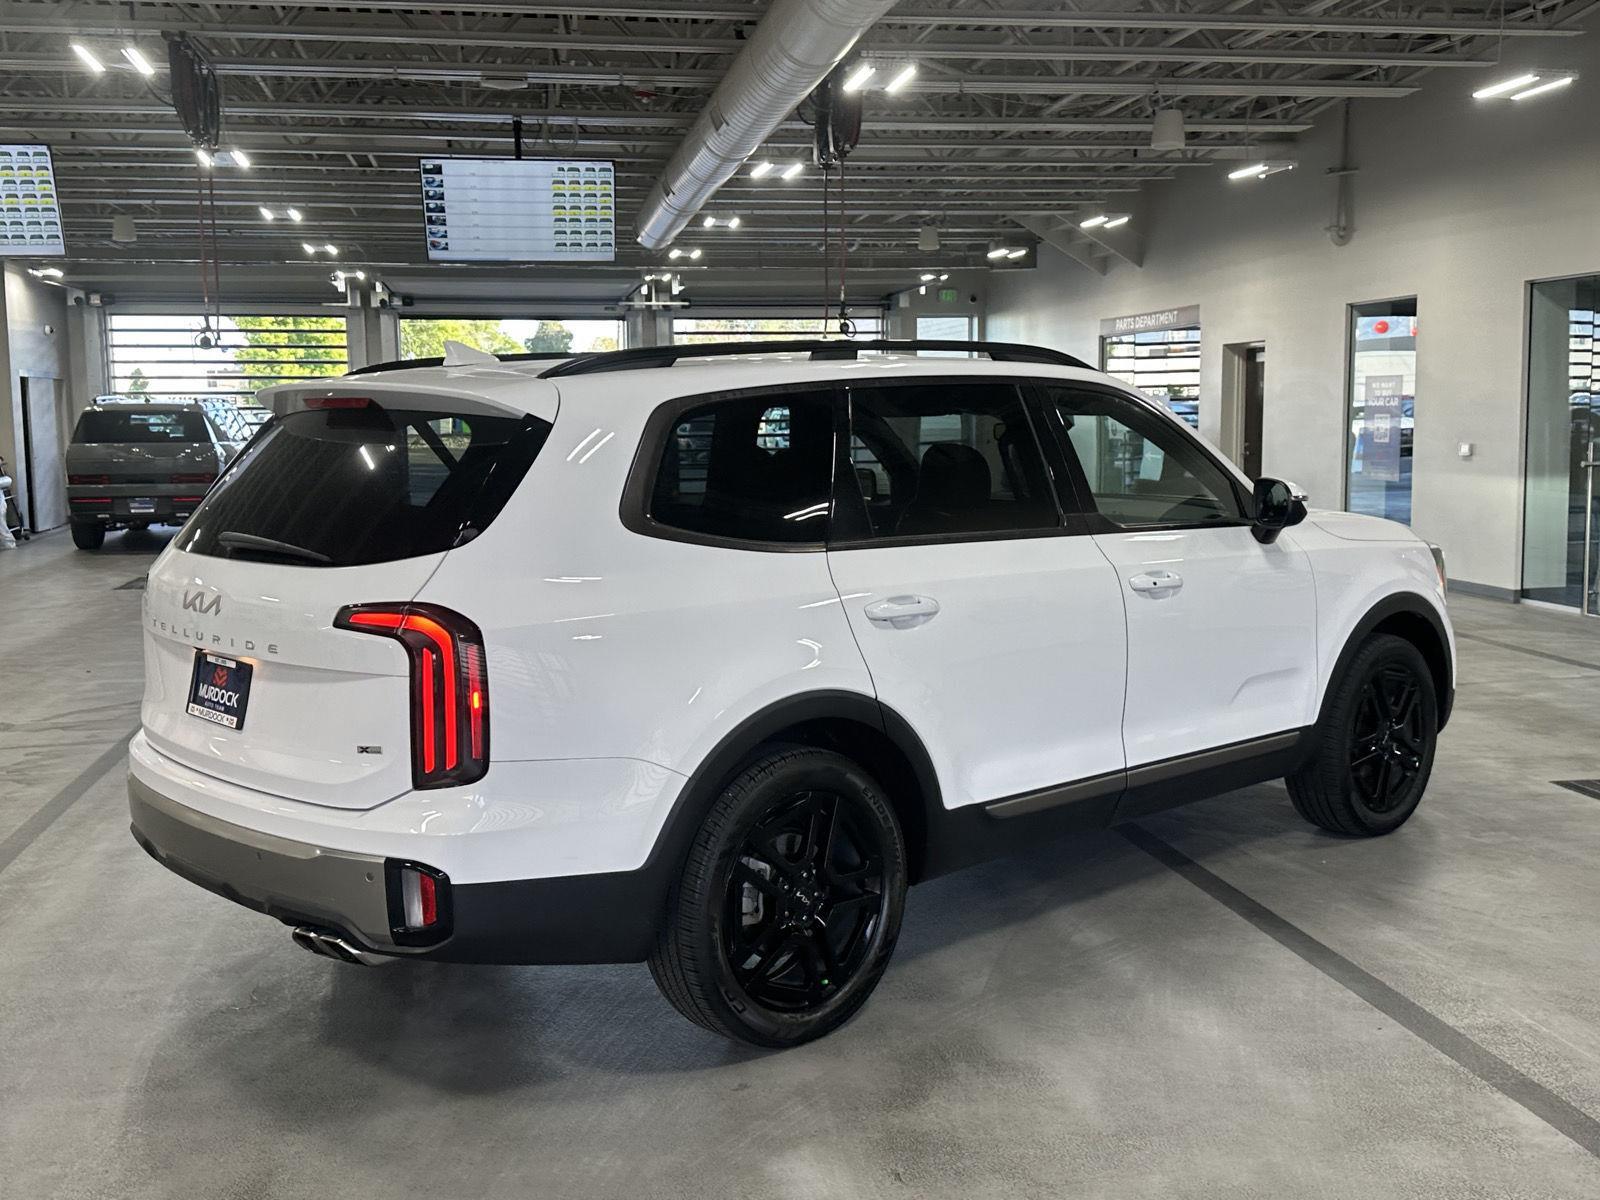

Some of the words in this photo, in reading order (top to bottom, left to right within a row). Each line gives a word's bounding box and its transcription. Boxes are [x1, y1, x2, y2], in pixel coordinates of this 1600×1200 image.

[1115, 318, 1135, 331] PARTS
[1135, 311, 1178, 328] DEPARTMENT
[1385, 398, 1399, 407] CAR
[182, 589, 222, 616] KIA
[151, 618, 279, 655] TELLURIDE
[198, 682, 240, 708] MURDOCK
[198, 707, 225, 723] MURDOCK
